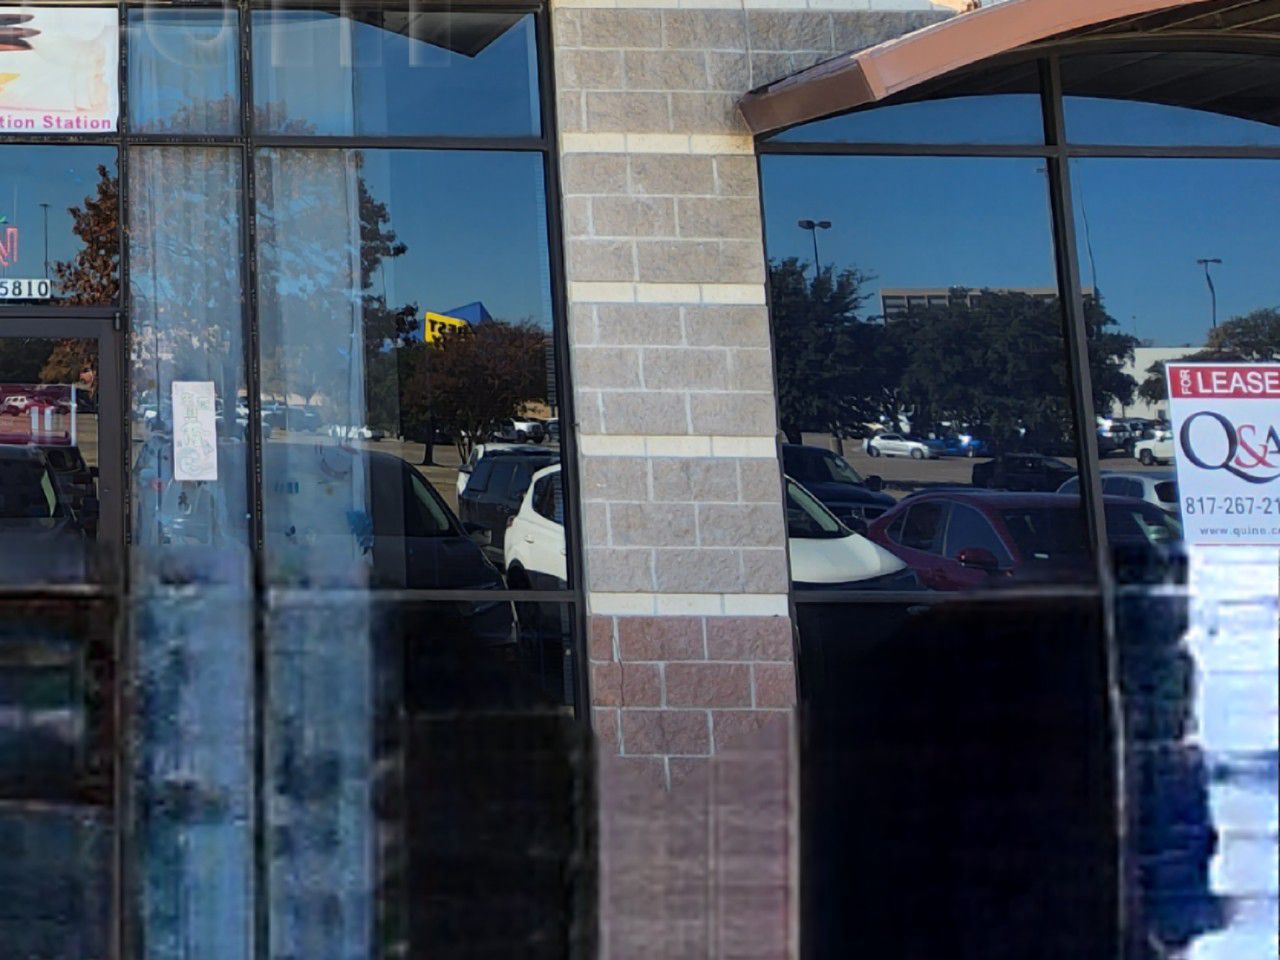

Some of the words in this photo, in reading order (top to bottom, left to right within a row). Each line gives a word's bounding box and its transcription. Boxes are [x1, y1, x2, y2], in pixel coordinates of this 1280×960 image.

[43, 114, 112, 130] Station
[1179, 369, 1192, 395] FOR
[1196, 371, 1280, 394] LEASE
[1200, 527, 1280, 538] www.quine.c
